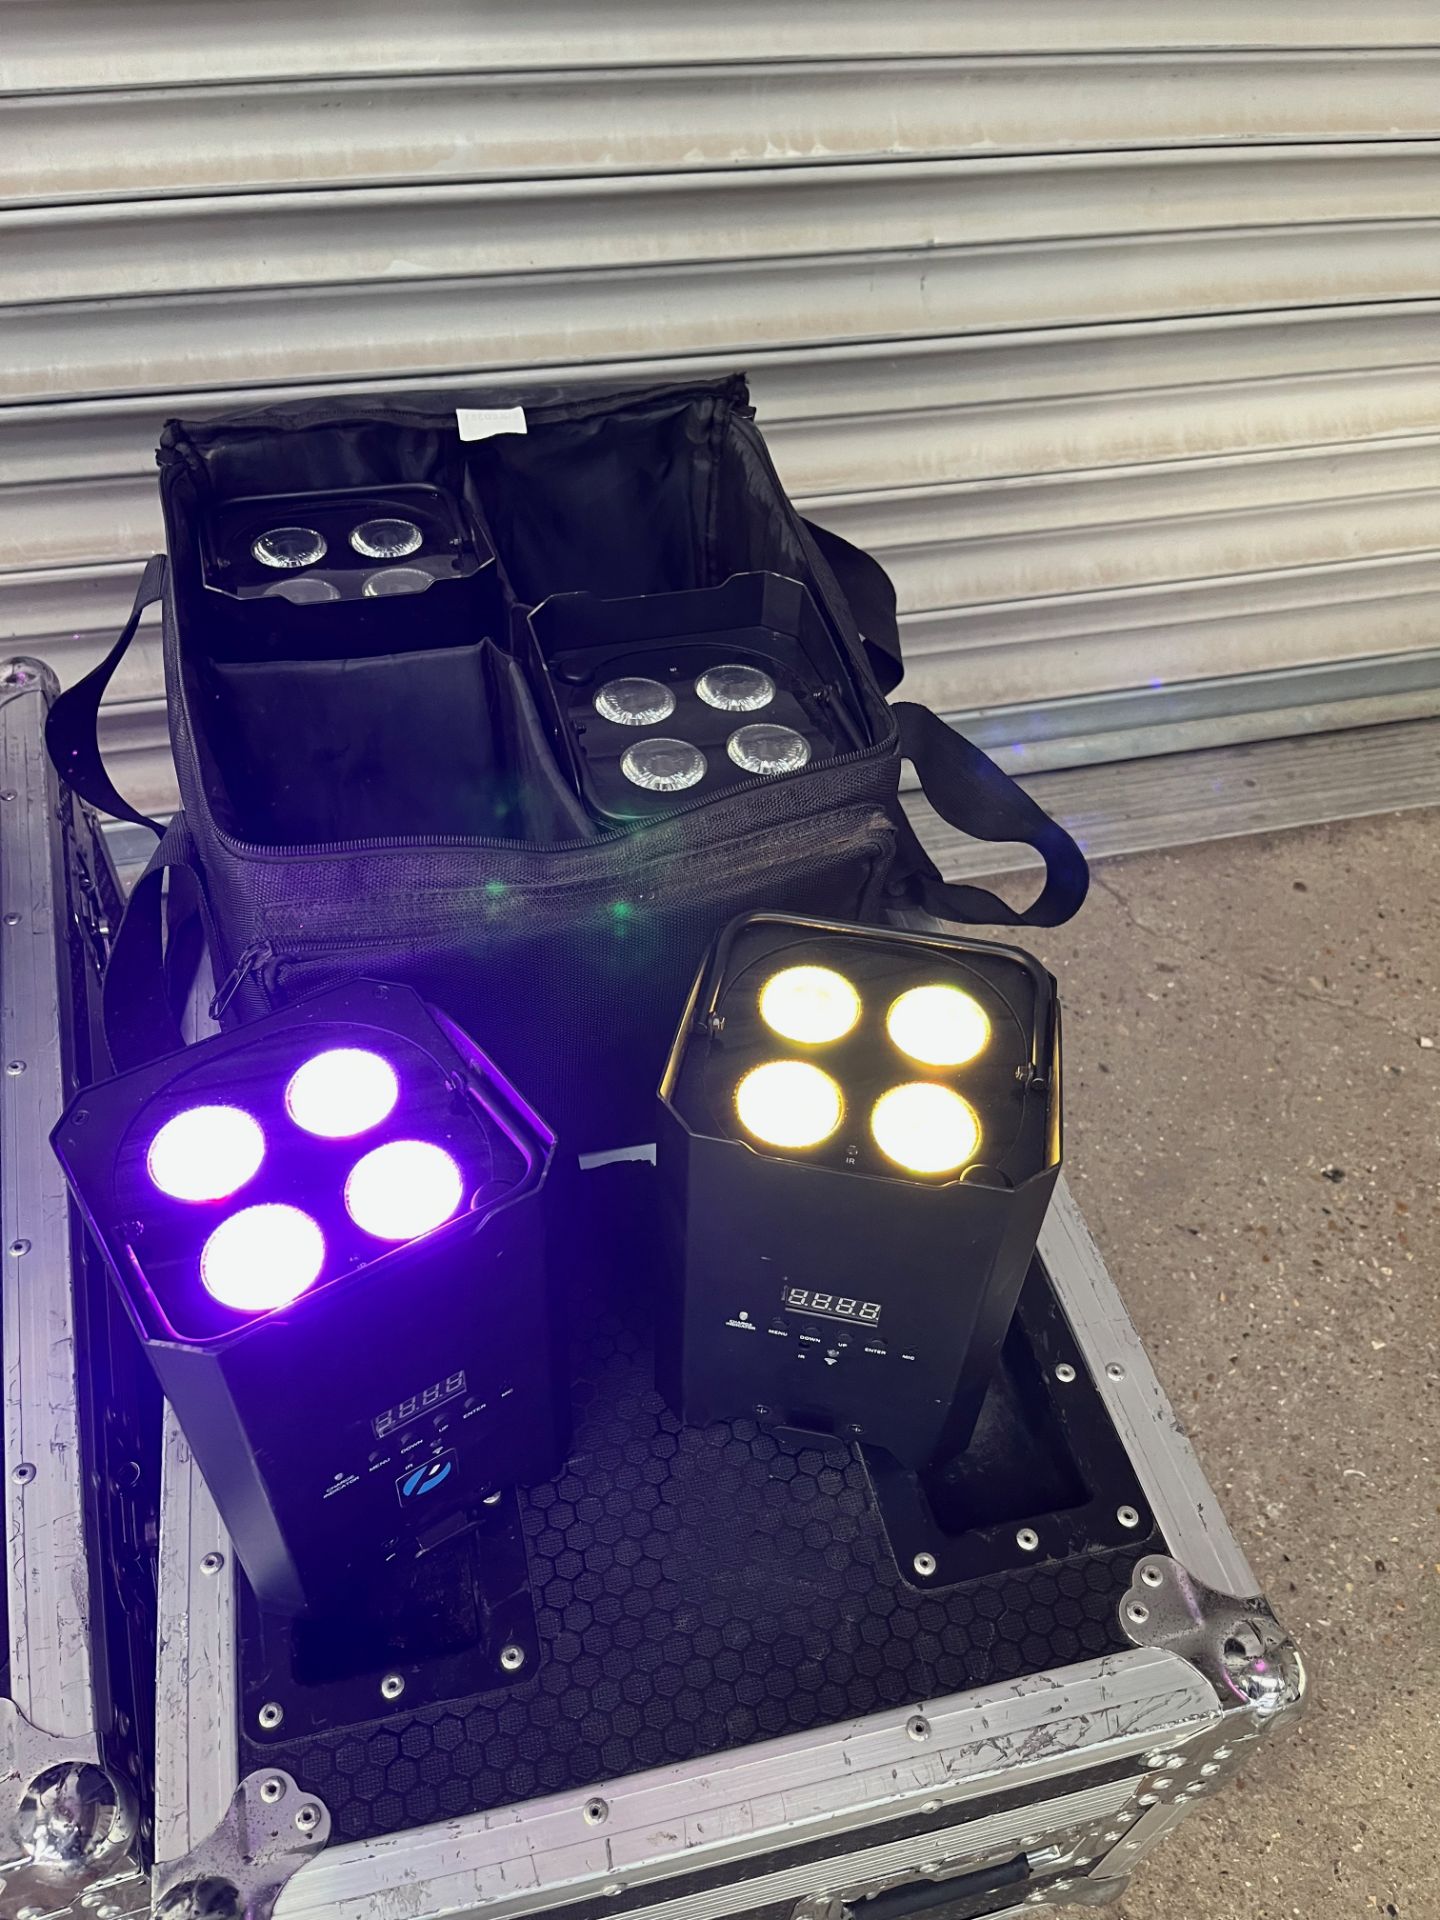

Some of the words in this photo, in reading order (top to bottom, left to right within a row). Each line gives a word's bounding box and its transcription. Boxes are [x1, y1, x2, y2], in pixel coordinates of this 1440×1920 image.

[845, 1157, 856, 1165] IR
[799, 1334, 821, 1343] DOWN
[864, 1347, 887, 1356] ENTER
[369, 1457, 391, 1472] MENU
[400, 1439, 423, 1454] DOWN
[439, 1424, 449, 1433] UP
[463, 1403, 487, 1419] ENTER
[323, 1475, 360, 1499] INDICATOR
[326, 1474, 355, 1493] CHARGE
